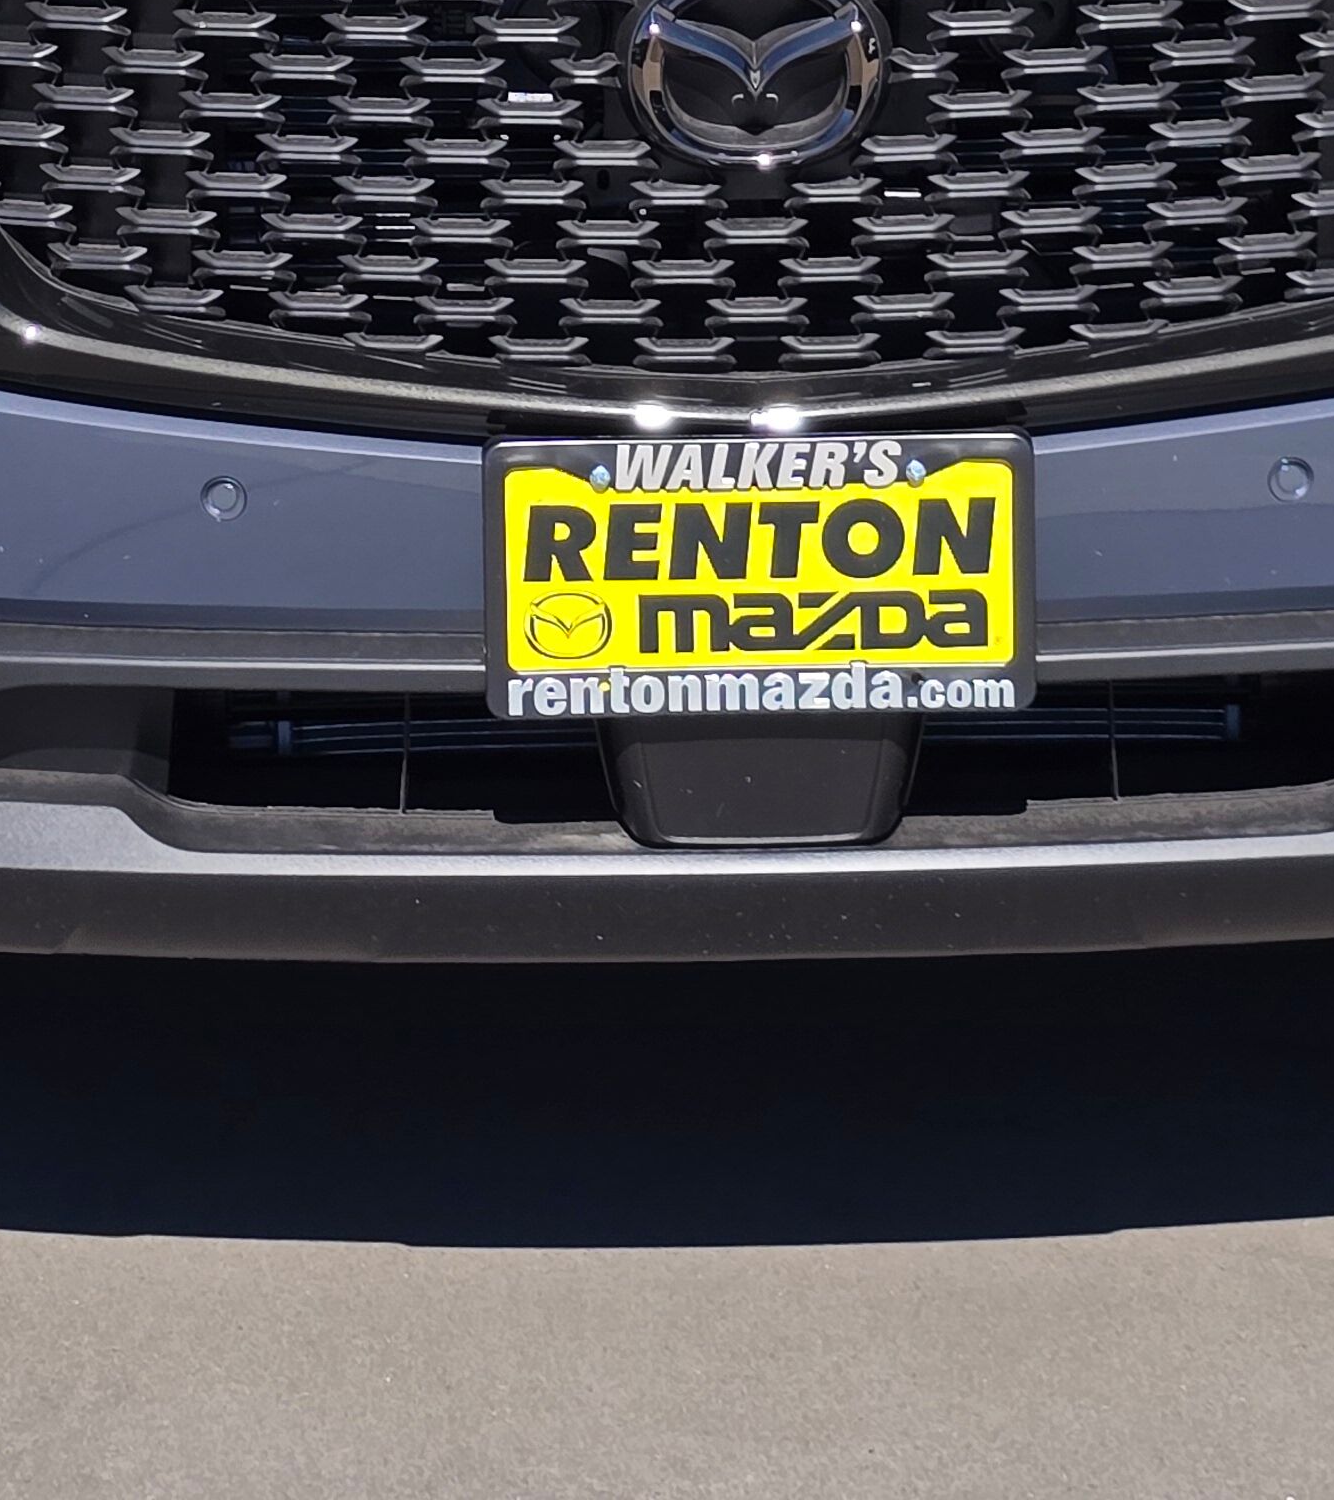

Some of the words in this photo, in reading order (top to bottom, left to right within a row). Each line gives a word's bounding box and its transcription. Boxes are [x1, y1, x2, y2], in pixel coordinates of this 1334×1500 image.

[615, 440, 902, 491] WALKER'S
[524, 497, 996, 582] RENTON
[638, 589, 989, 653] mazda
[507, 661, 1016, 716] rentonmazda.com
